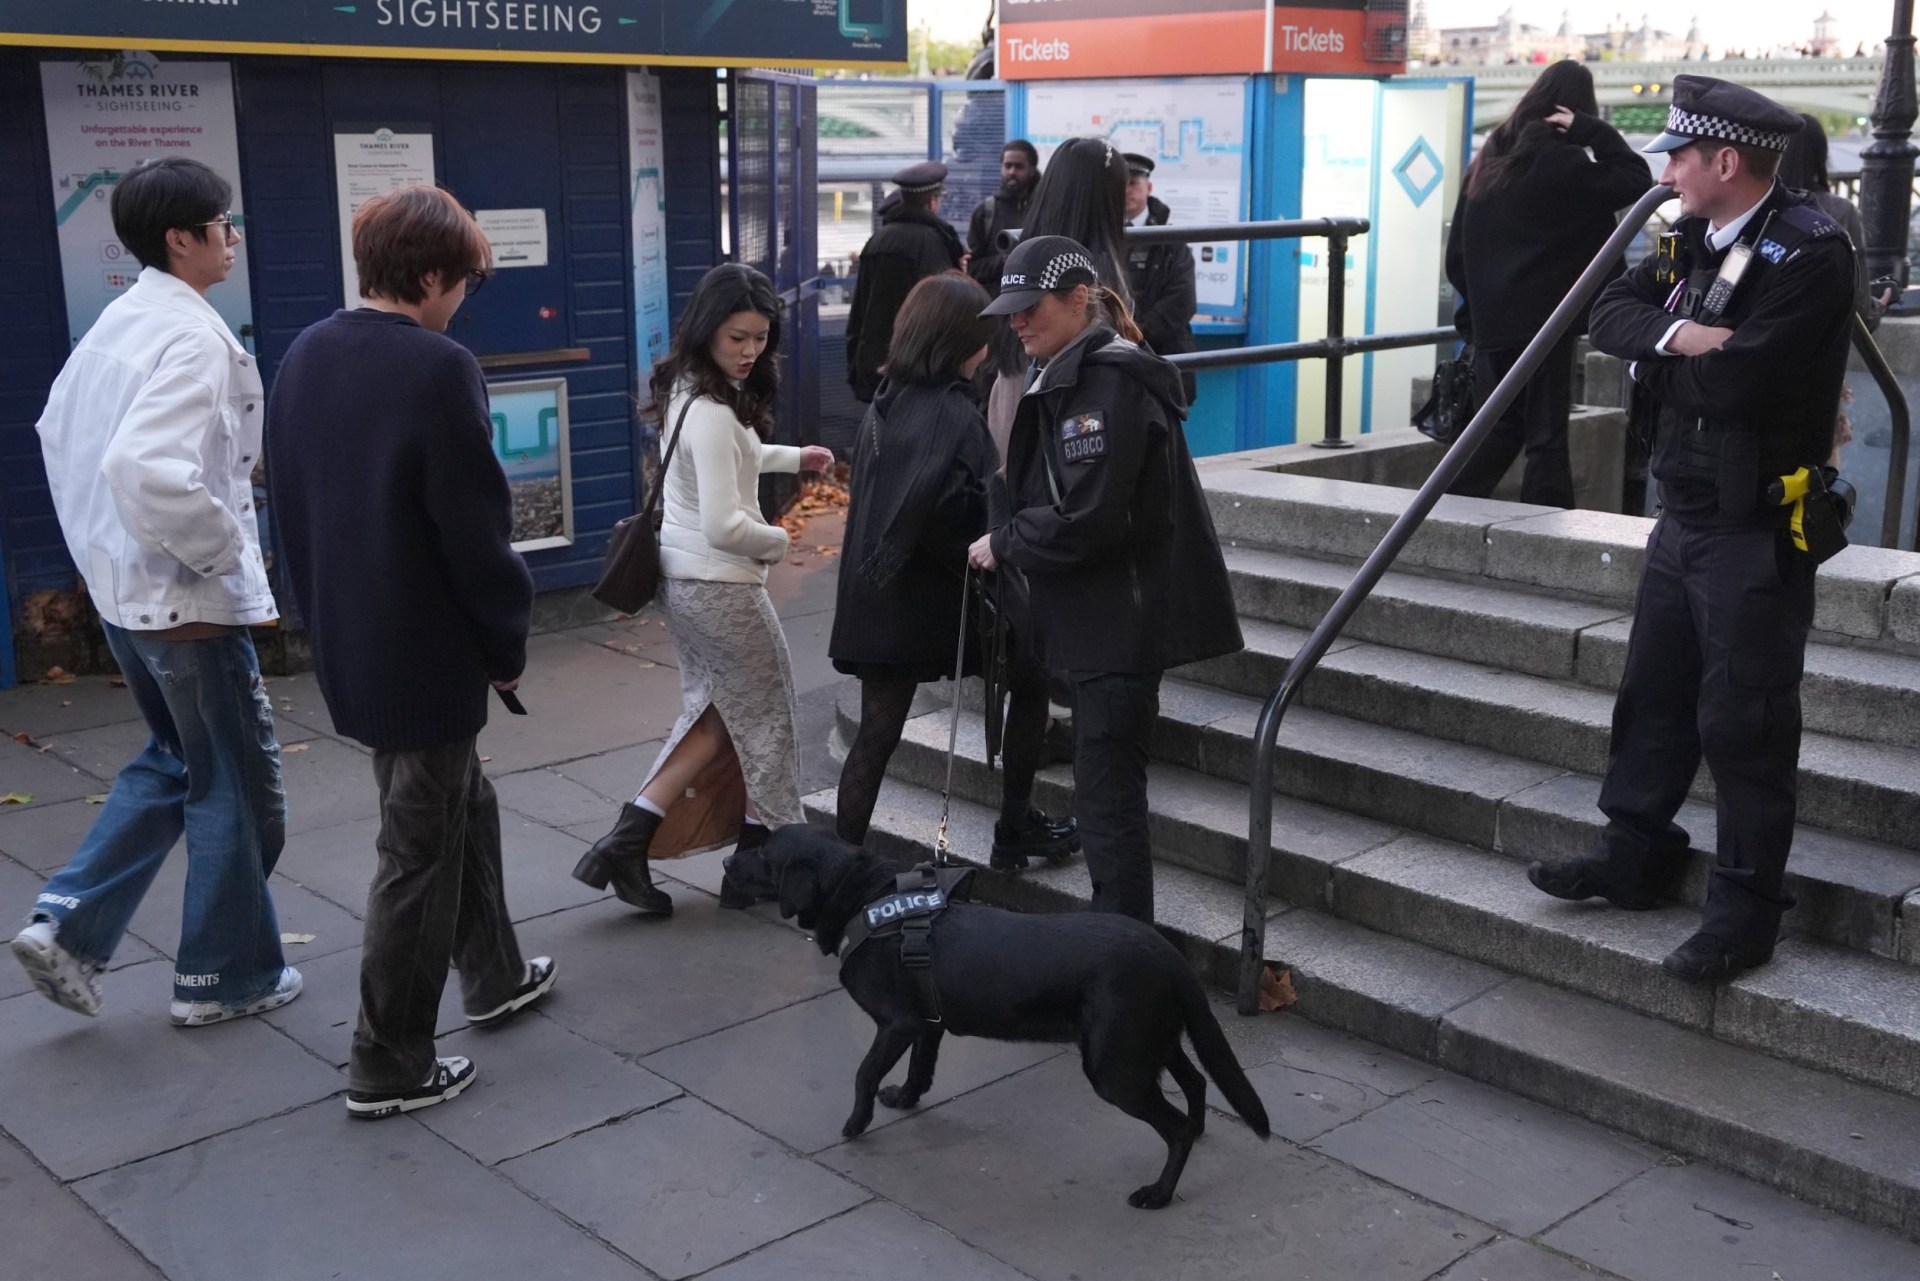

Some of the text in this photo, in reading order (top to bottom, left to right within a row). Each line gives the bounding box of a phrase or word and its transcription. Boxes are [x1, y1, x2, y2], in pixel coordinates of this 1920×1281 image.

[377, 0, 601, 33] SIGHTSEEING
[1282, 25, 1345, 53] Tickets
[1007, 38, 1070, 61] Tickets
[77, 84, 199, 97] THAMES RIVER
[97, 101, 182, 112] SIGHTSEEING
[81, 125, 203, 136] Unforgettable experience
[110, 139, 126, 147] the
[128, 139, 152, 147] River
[154, 139, 191, 147] Thames
[1001, 275, 1026, 285] OLICE
[868, 893, 941, 924] POLICE
